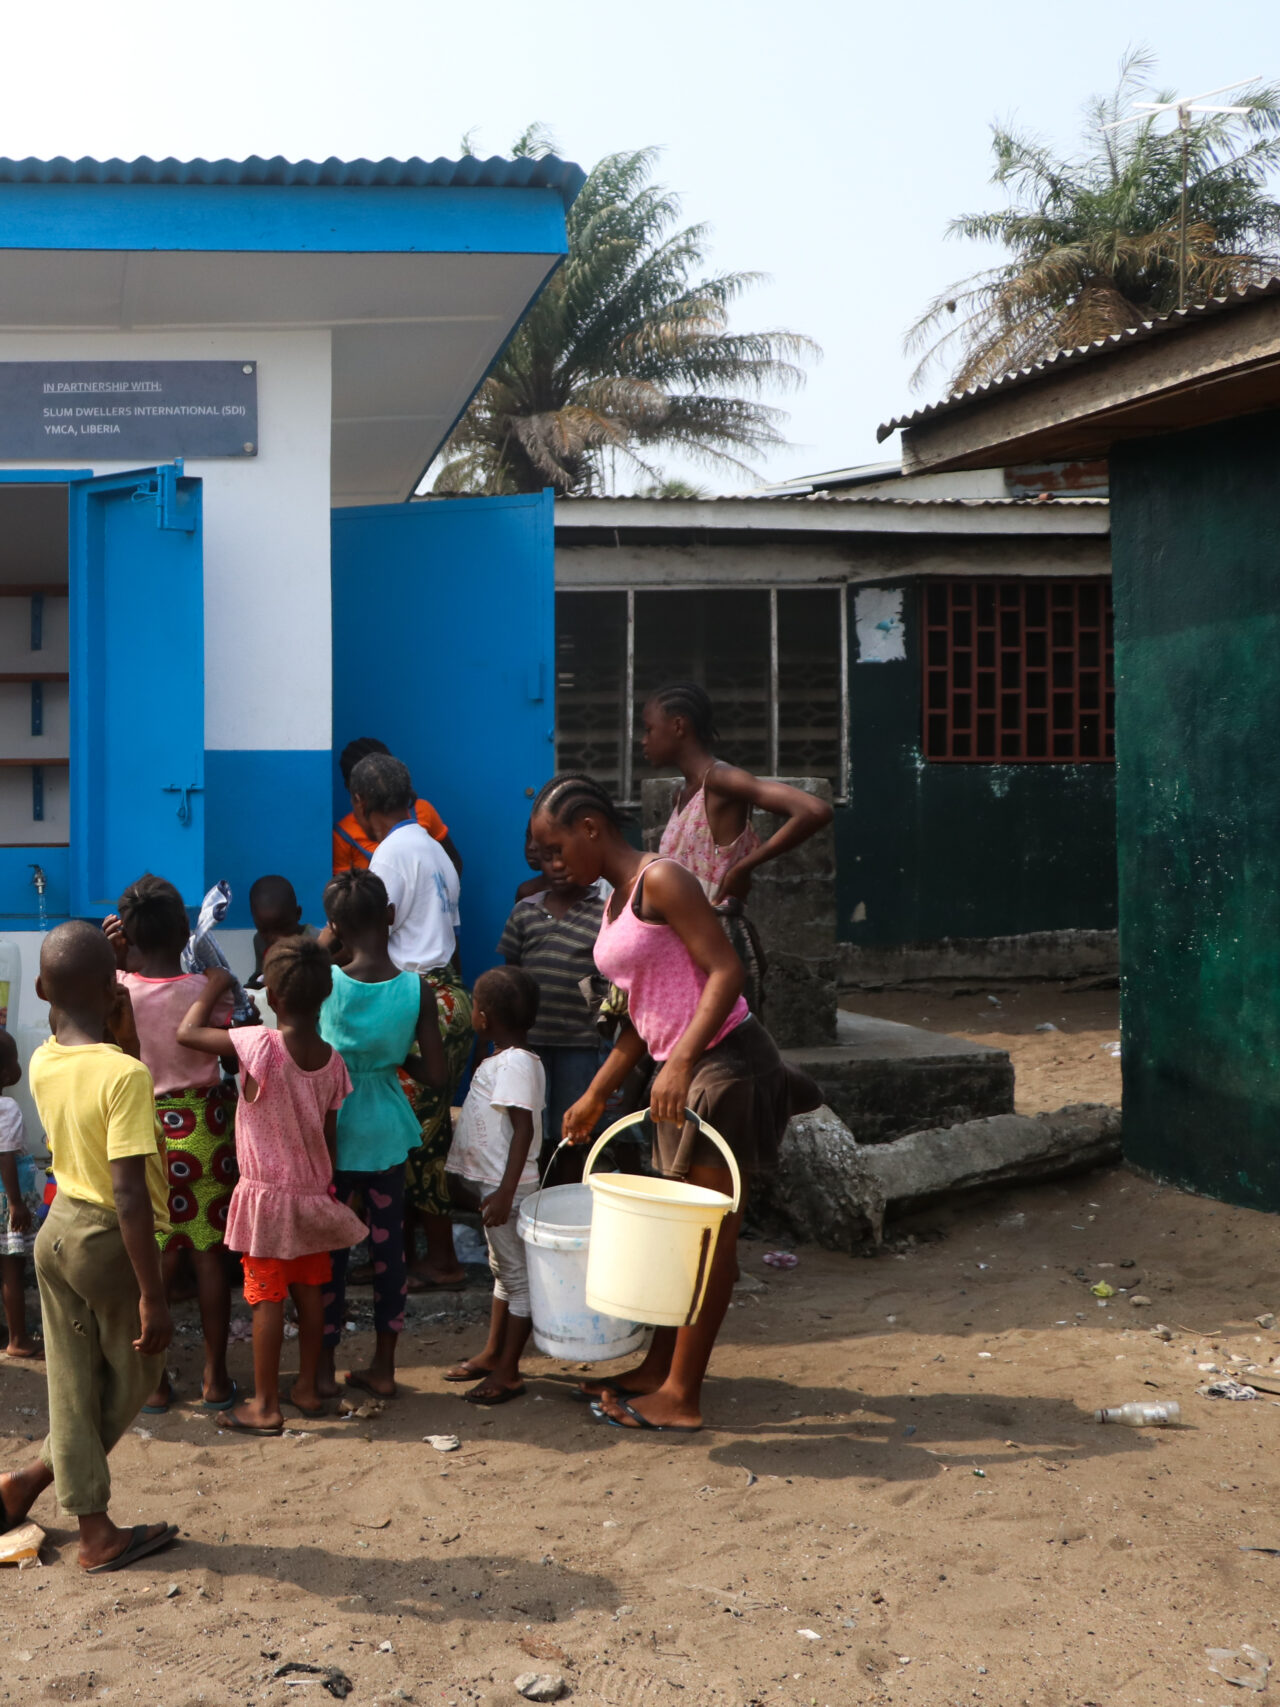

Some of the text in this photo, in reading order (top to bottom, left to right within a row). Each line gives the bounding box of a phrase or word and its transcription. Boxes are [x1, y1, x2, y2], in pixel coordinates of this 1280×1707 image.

[43, 382, 55, 393] IN
[57, 382, 130, 392] PARTNERSHIP
[43, 405, 246, 417] SLUM DWELLERS INTERNATIONAL (SDI)
[44, 424, 121, 436] YMCA, LIBERIA
